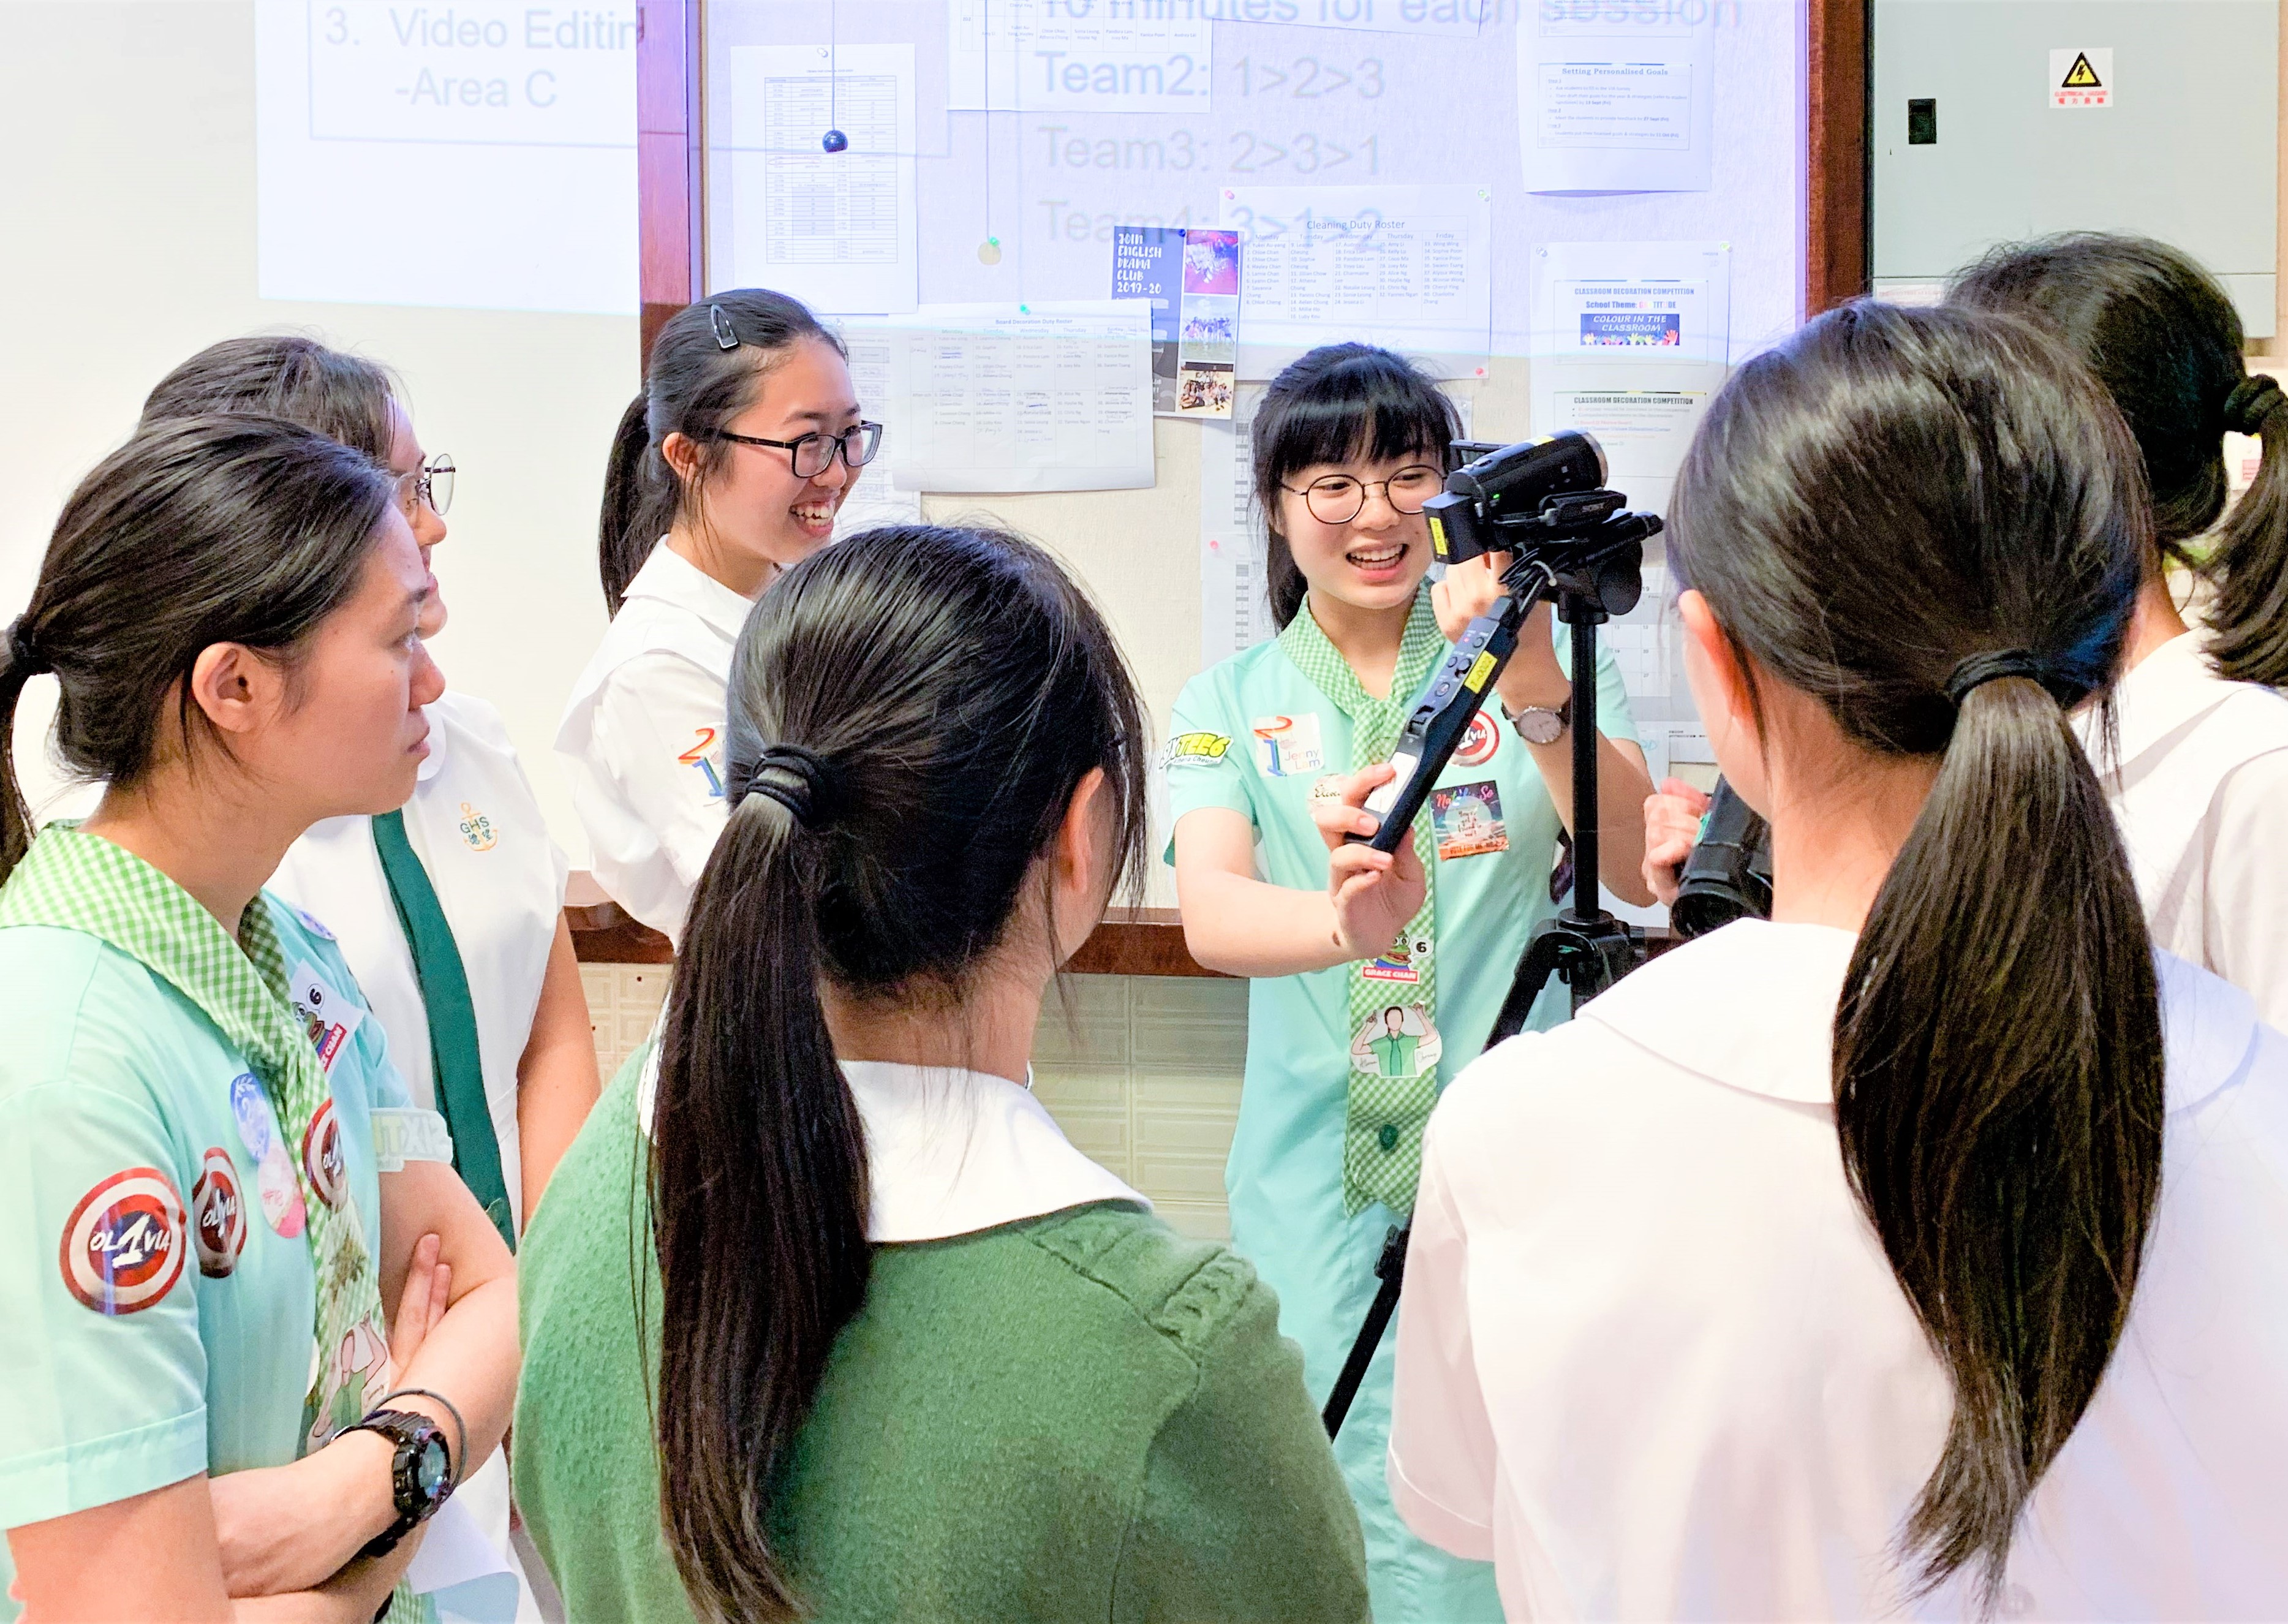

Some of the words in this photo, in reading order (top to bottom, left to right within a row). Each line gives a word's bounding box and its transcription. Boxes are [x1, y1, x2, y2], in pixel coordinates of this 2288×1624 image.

[325, 7, 360, 45] 3.
[388, 8, 508, 48] Video
[524, 9, 643, 50] Editin
[1035, 50, 1207, 96] Team2:
[524, 69, 558, 108] C
[1037, 125, 1209, 172] Team3:
[1307, 221, 1348, 231] Cleaning
[1350, 220, 1372, 230] Duty
[1374, 220, 1405, 229] Roster
[1118, 233, 1144, 245] JOIN
[1118, 245, 1162, 258] ENGLISH
[1117, 257, 1150, 270] DRAMA
[1117, 269, 1144, 281] CLUB
[1117, 281, 1162, 294] 2019-20
[1284, 749, 1320, 761] Jenny
[460, 817, 489, 834] GHS
[1416, 942, 1427, 953] 6
[1364, 968, 1392, 977] GRACE
[309, 988, 322, 1005] 6
